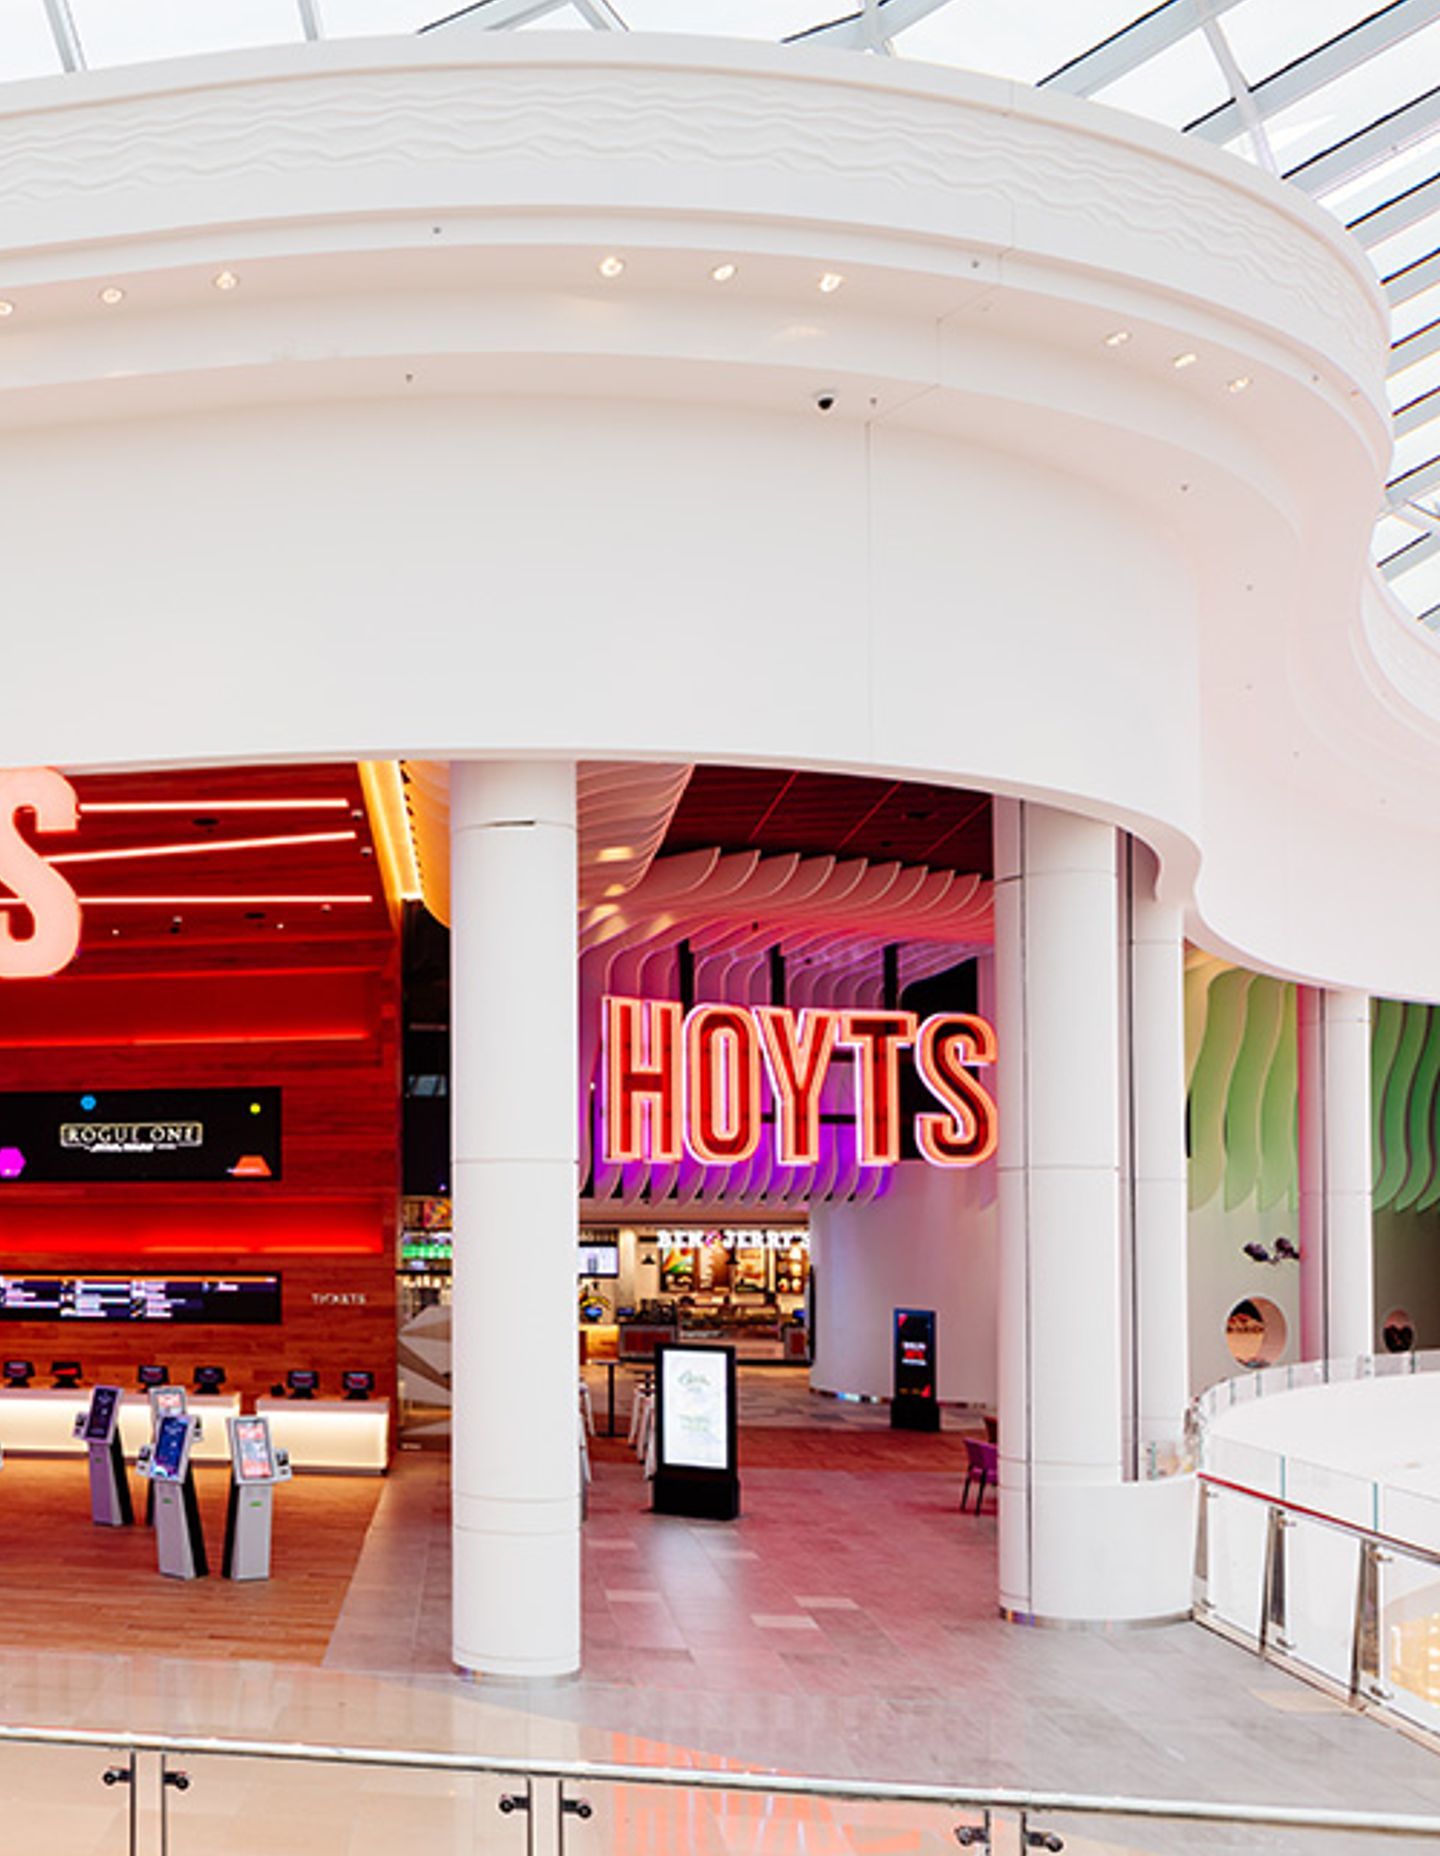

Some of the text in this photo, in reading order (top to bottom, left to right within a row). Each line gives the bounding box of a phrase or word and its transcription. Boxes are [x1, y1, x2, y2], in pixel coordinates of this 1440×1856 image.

[602, 996, 998, 1165] HOYTS
[64, 1125, 194, 1143] ROGUE ONE
[656, 1229, 704, 1248] BEN
